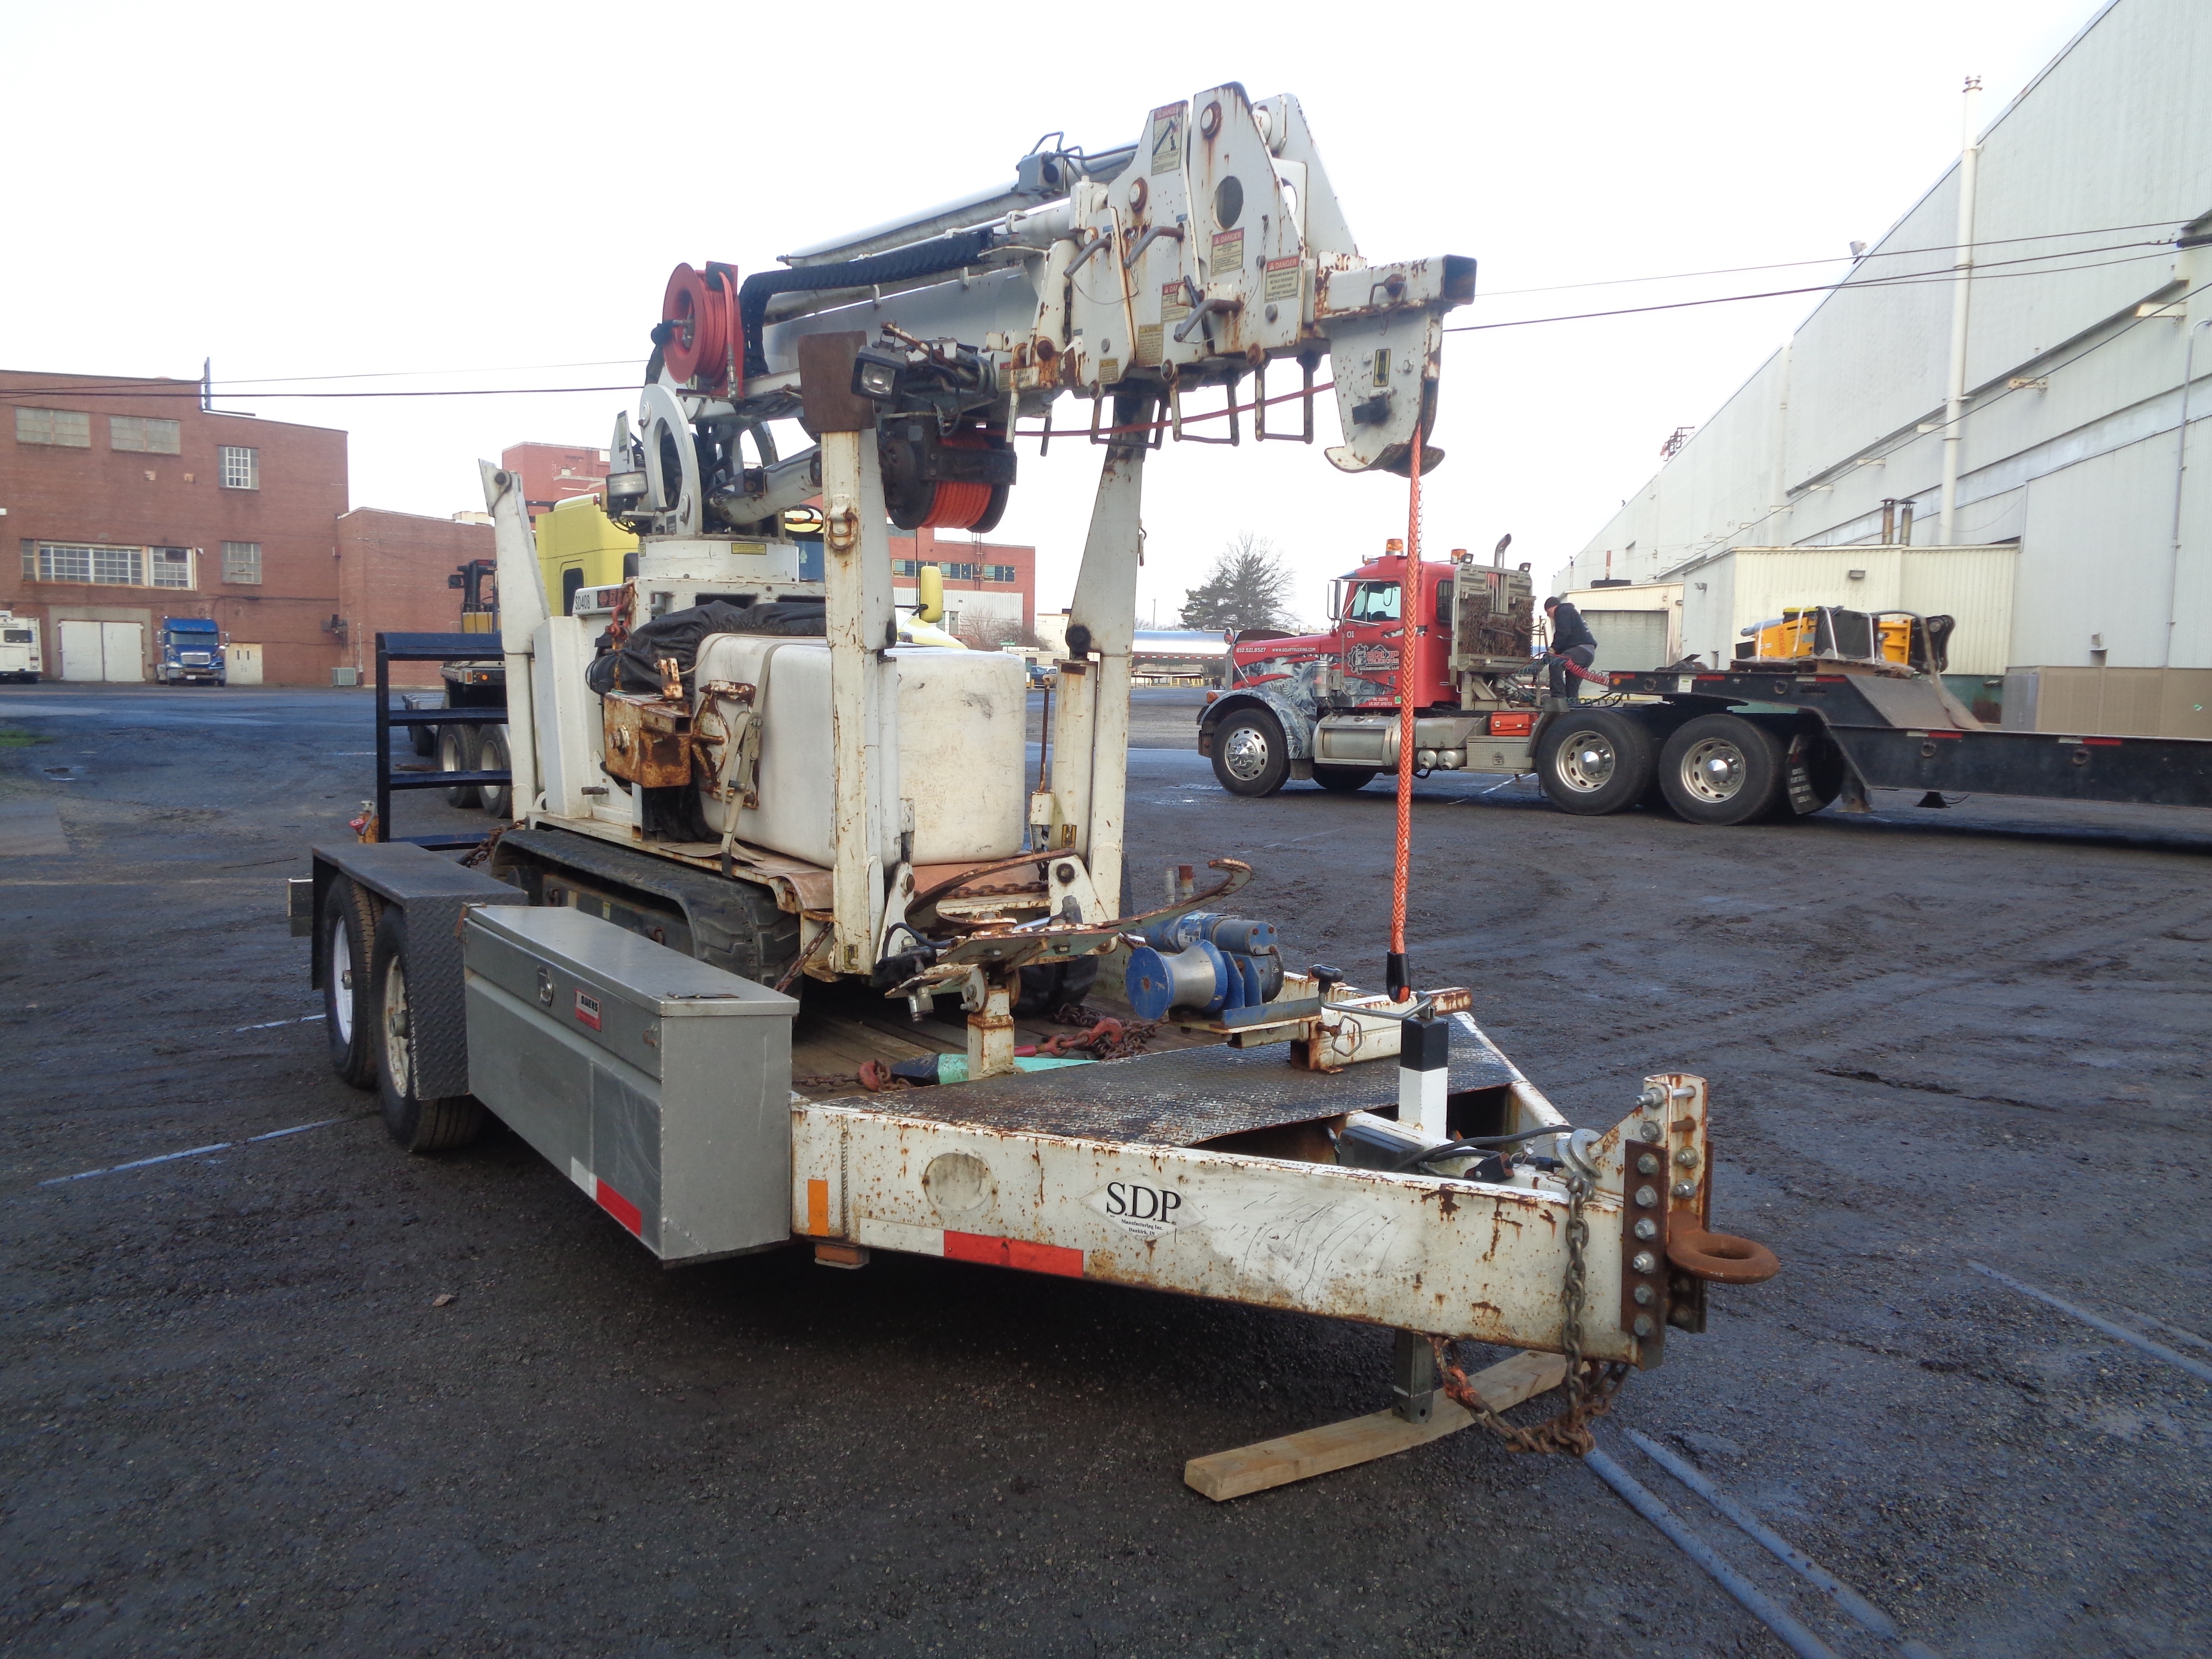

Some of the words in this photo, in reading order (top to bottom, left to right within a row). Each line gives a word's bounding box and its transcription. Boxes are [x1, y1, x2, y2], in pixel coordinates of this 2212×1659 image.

[1221, 232, 1241, 242] DANGER
[1275, 259, 1297, 269] DANGER
[575, 595, 590, 610] SD408
[1367, 650, 1400, 659] EQUIP
[581, 995, 598, 1012] OWENS
[1121, 1219, 1154, 1229] Manufacturing
